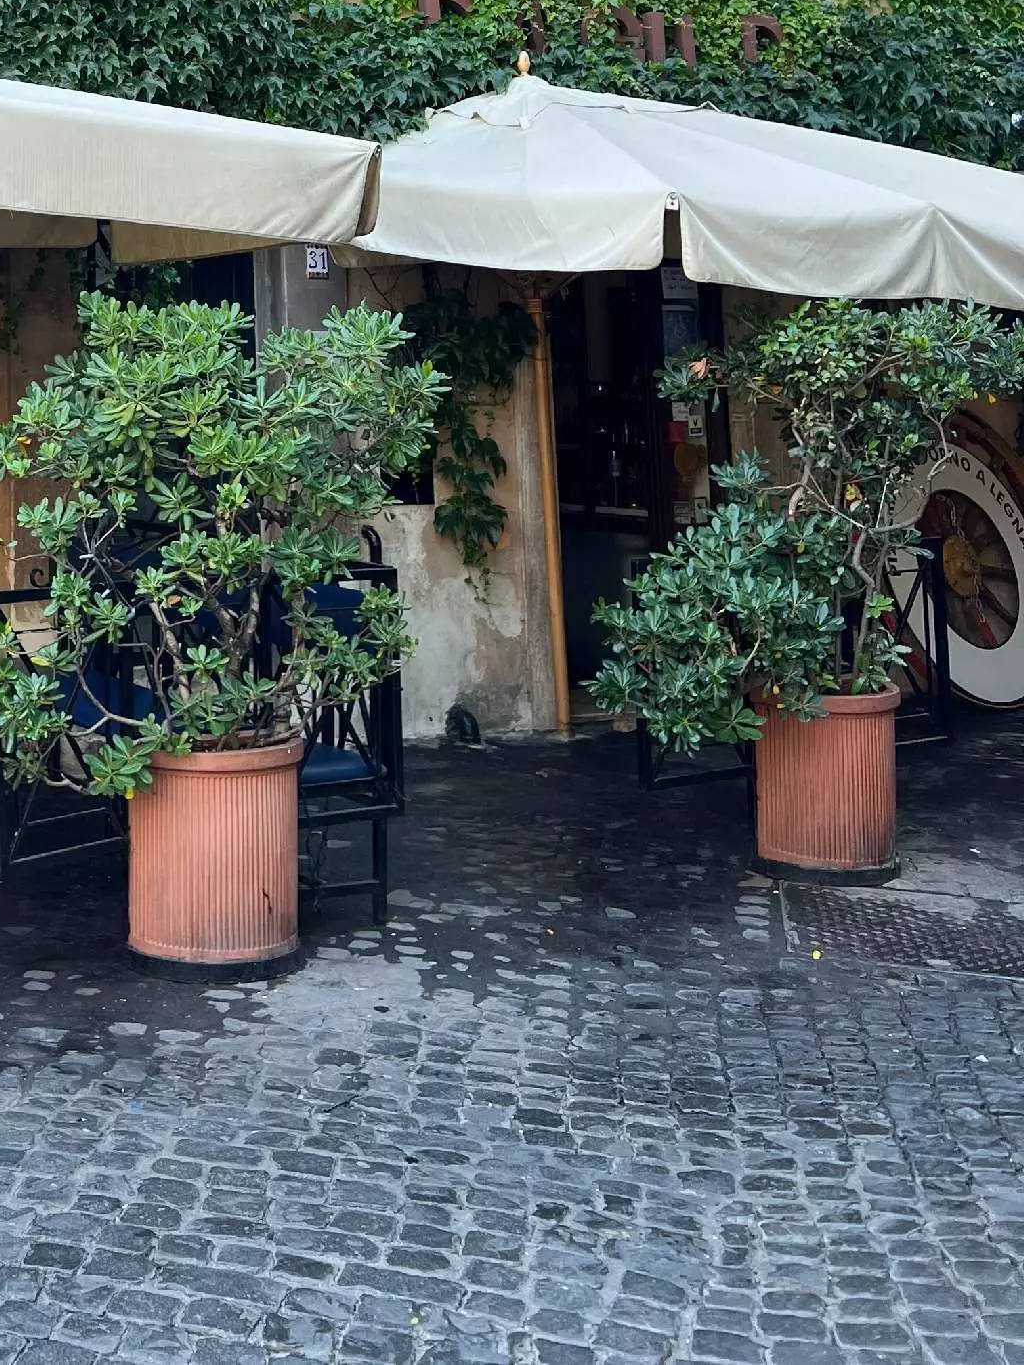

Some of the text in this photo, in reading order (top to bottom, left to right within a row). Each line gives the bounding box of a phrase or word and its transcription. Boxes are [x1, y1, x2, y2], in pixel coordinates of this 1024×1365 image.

[308, 250, 327, 270] 31
[928, 447, 971, 472] ORNO
[976, 470, 985, 485] A
